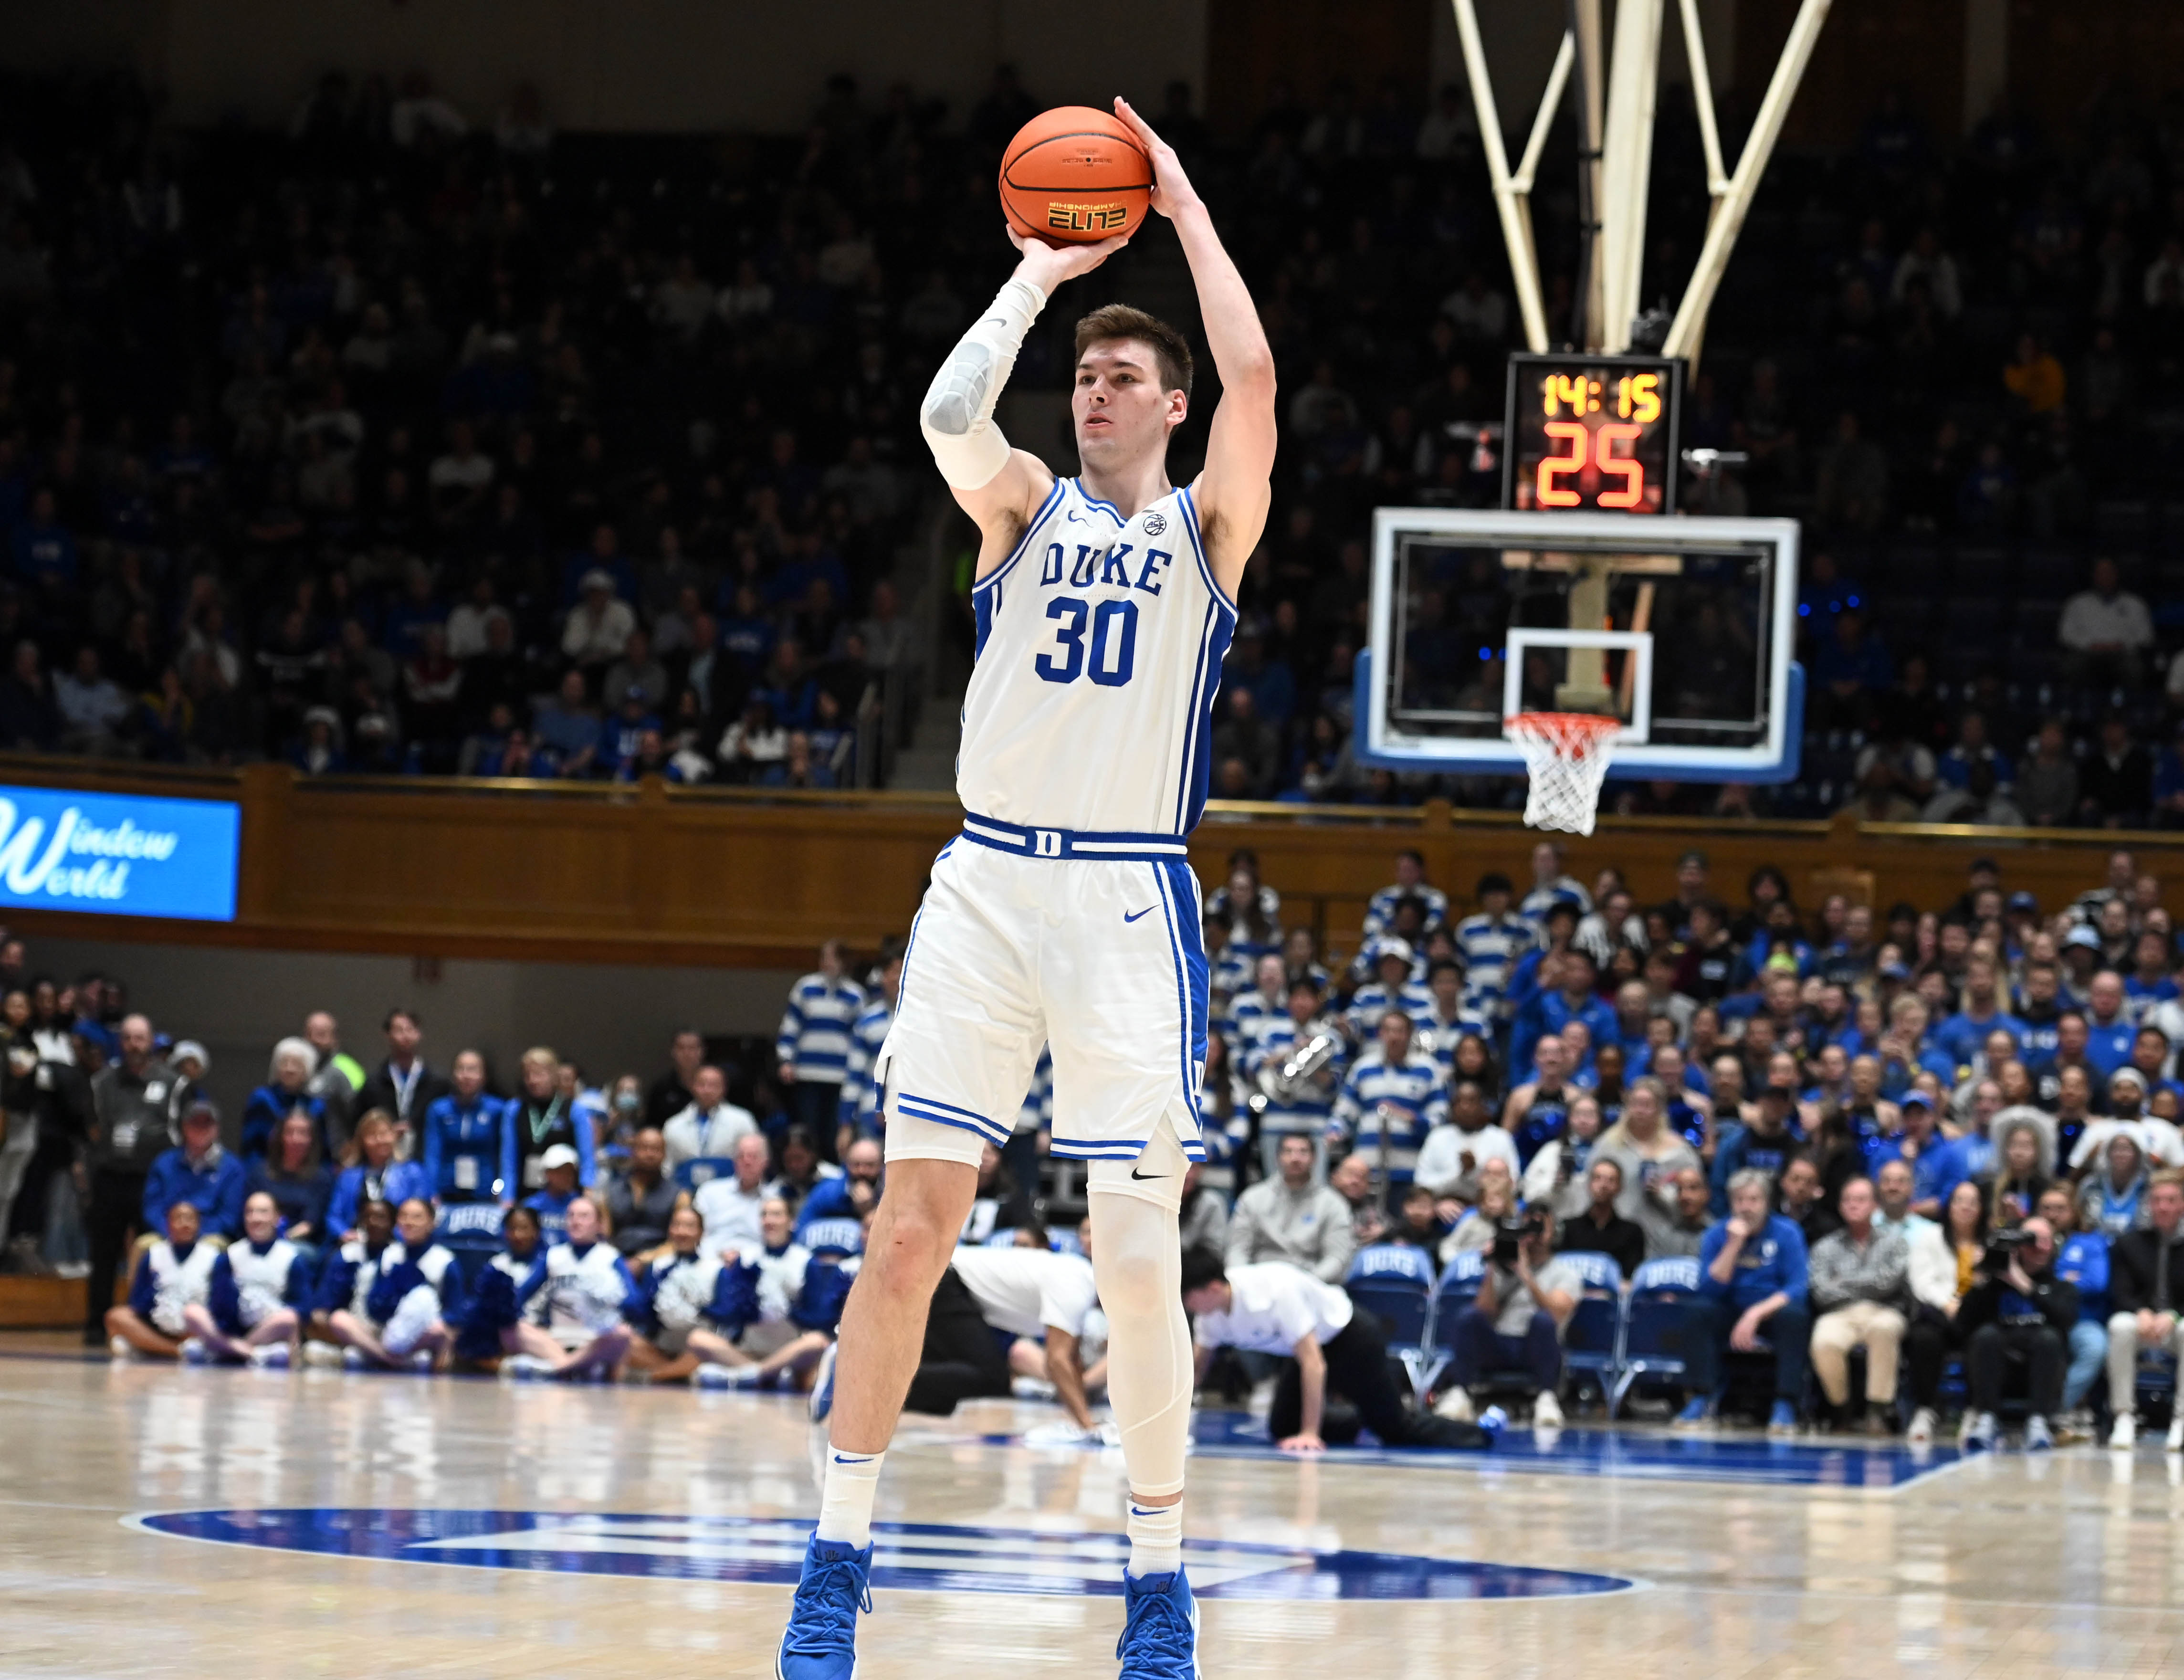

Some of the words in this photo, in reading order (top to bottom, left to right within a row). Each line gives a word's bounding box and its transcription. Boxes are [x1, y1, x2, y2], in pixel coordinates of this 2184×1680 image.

[1048, 207, 1126, 231] ELITE
[1544, 374, 1661, 423] 14:15
[1537, 422, 1643, 507] 25
[1040, 543, 1172, 597] DUKE
[1035, 596, 1139, 687] 30
